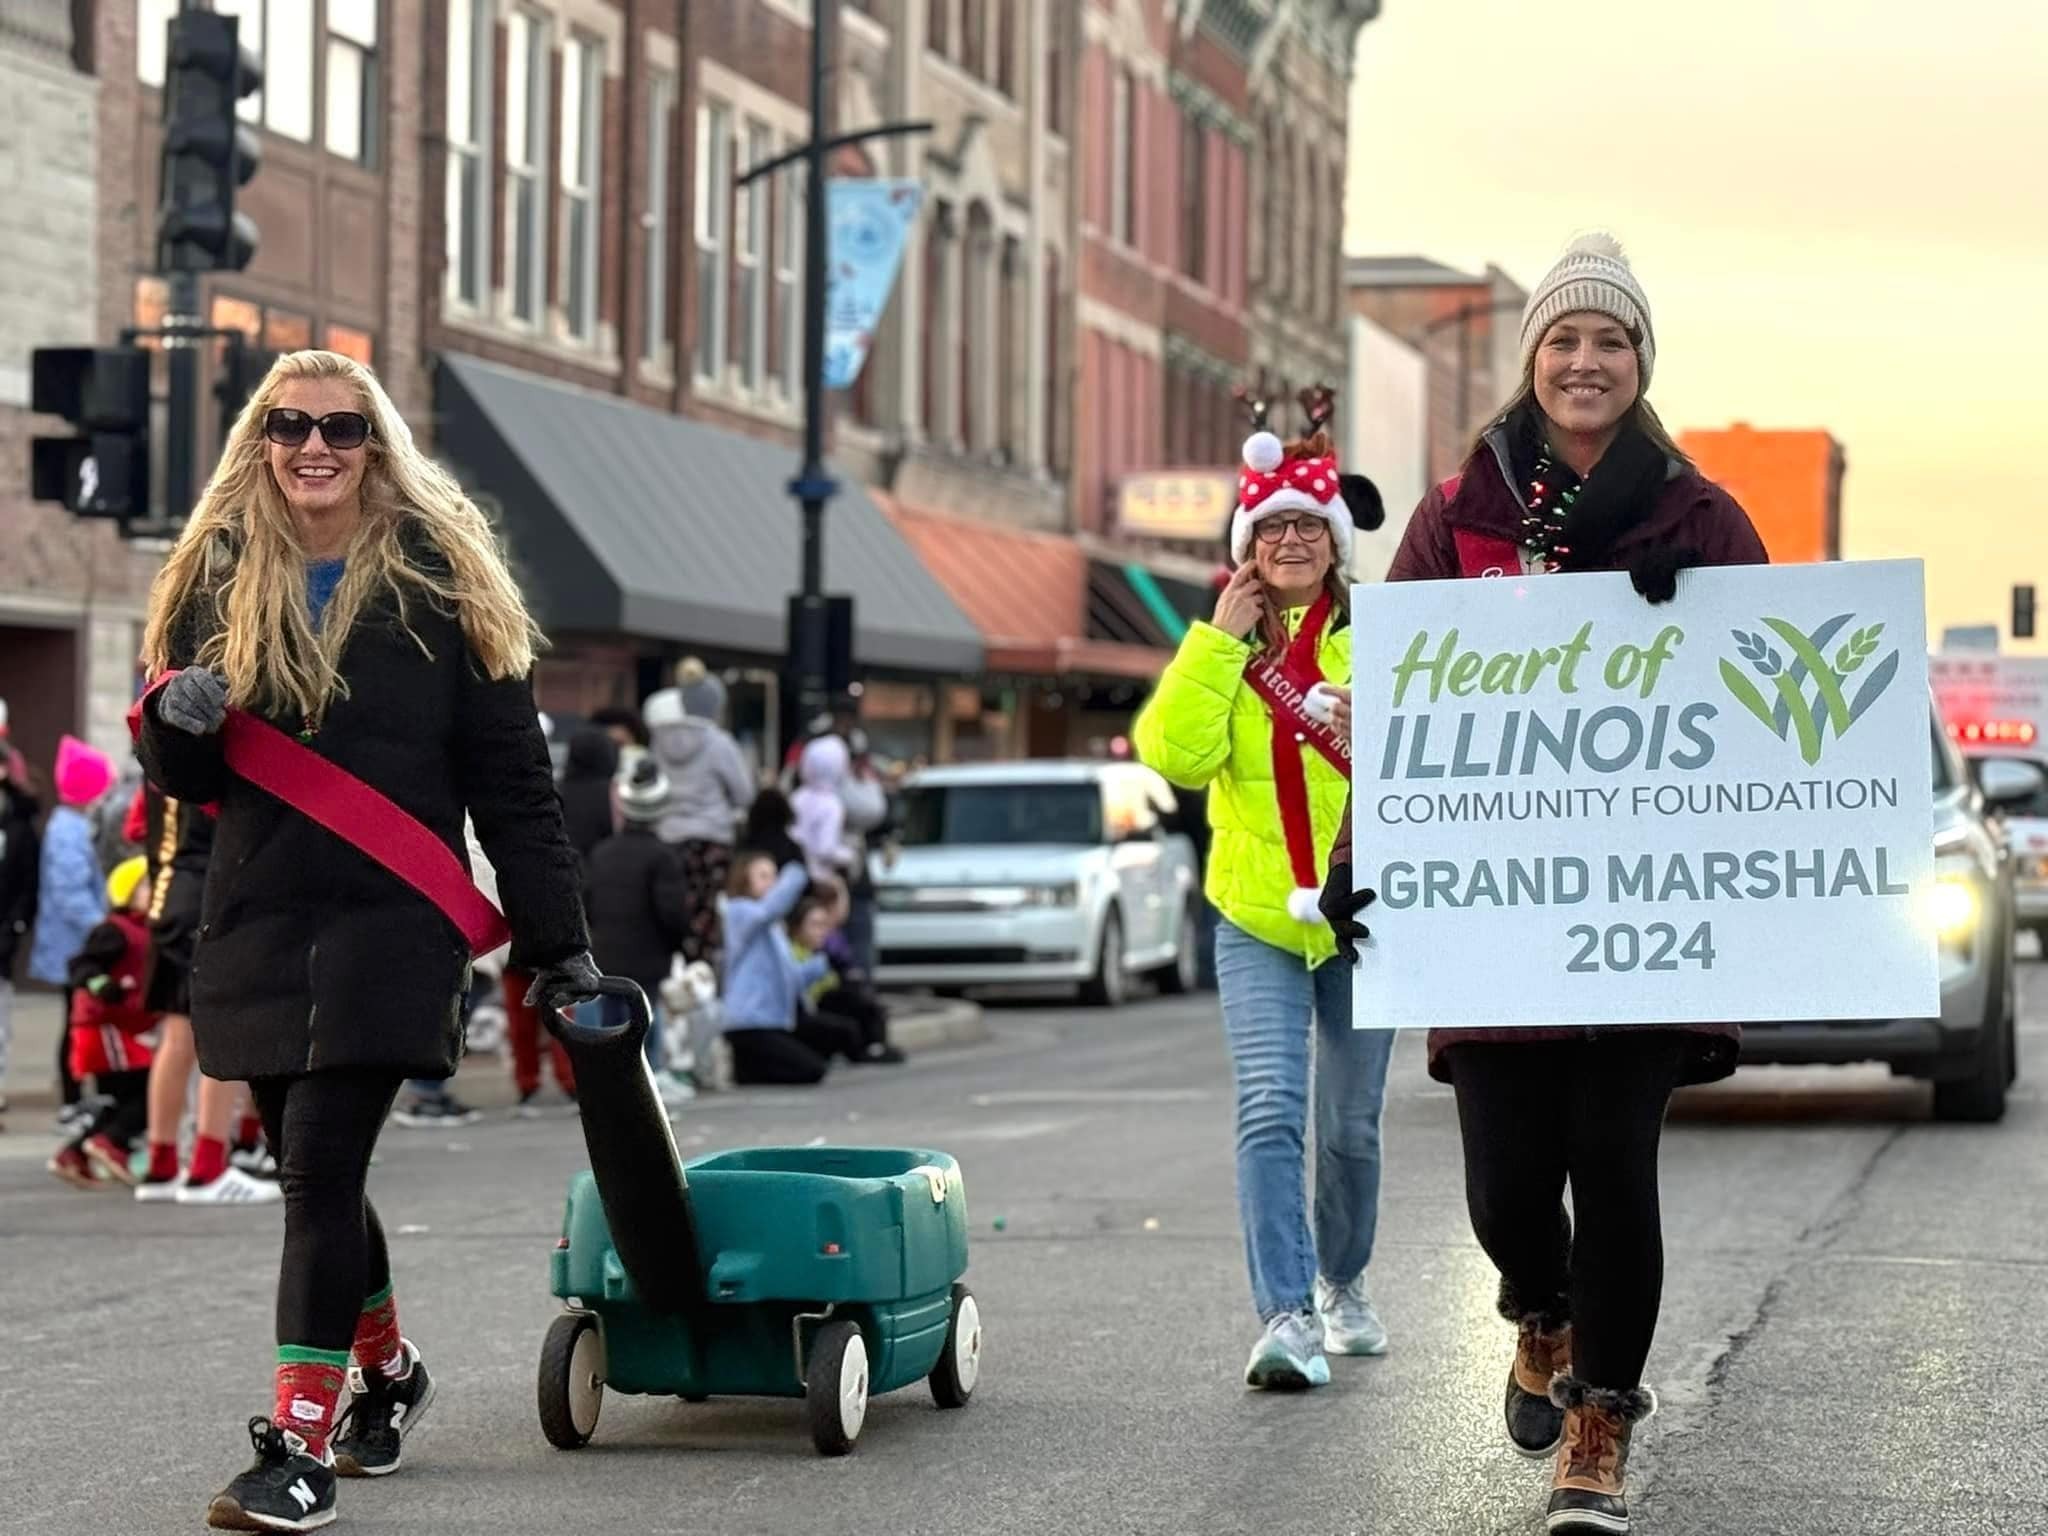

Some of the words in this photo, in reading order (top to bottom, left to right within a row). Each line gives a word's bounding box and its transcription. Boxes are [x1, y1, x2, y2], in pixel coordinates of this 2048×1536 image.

[1391, 621, 1594, 708] Heart
[1604, 624, 1685, 699] of
[1380, 702, 1720, 780] ILLINOIS
[1377, 787, 1620, 825] COMMUNITY
[1632, 778, 1899, 816] FOUNDATION
[1381, 857, 1590, 909] GRAND
[1607, 847, 1909, 904] MARSHAL
[1566, 921, 1716, 973] 2024
[288, 1477, 317, 1513] N
